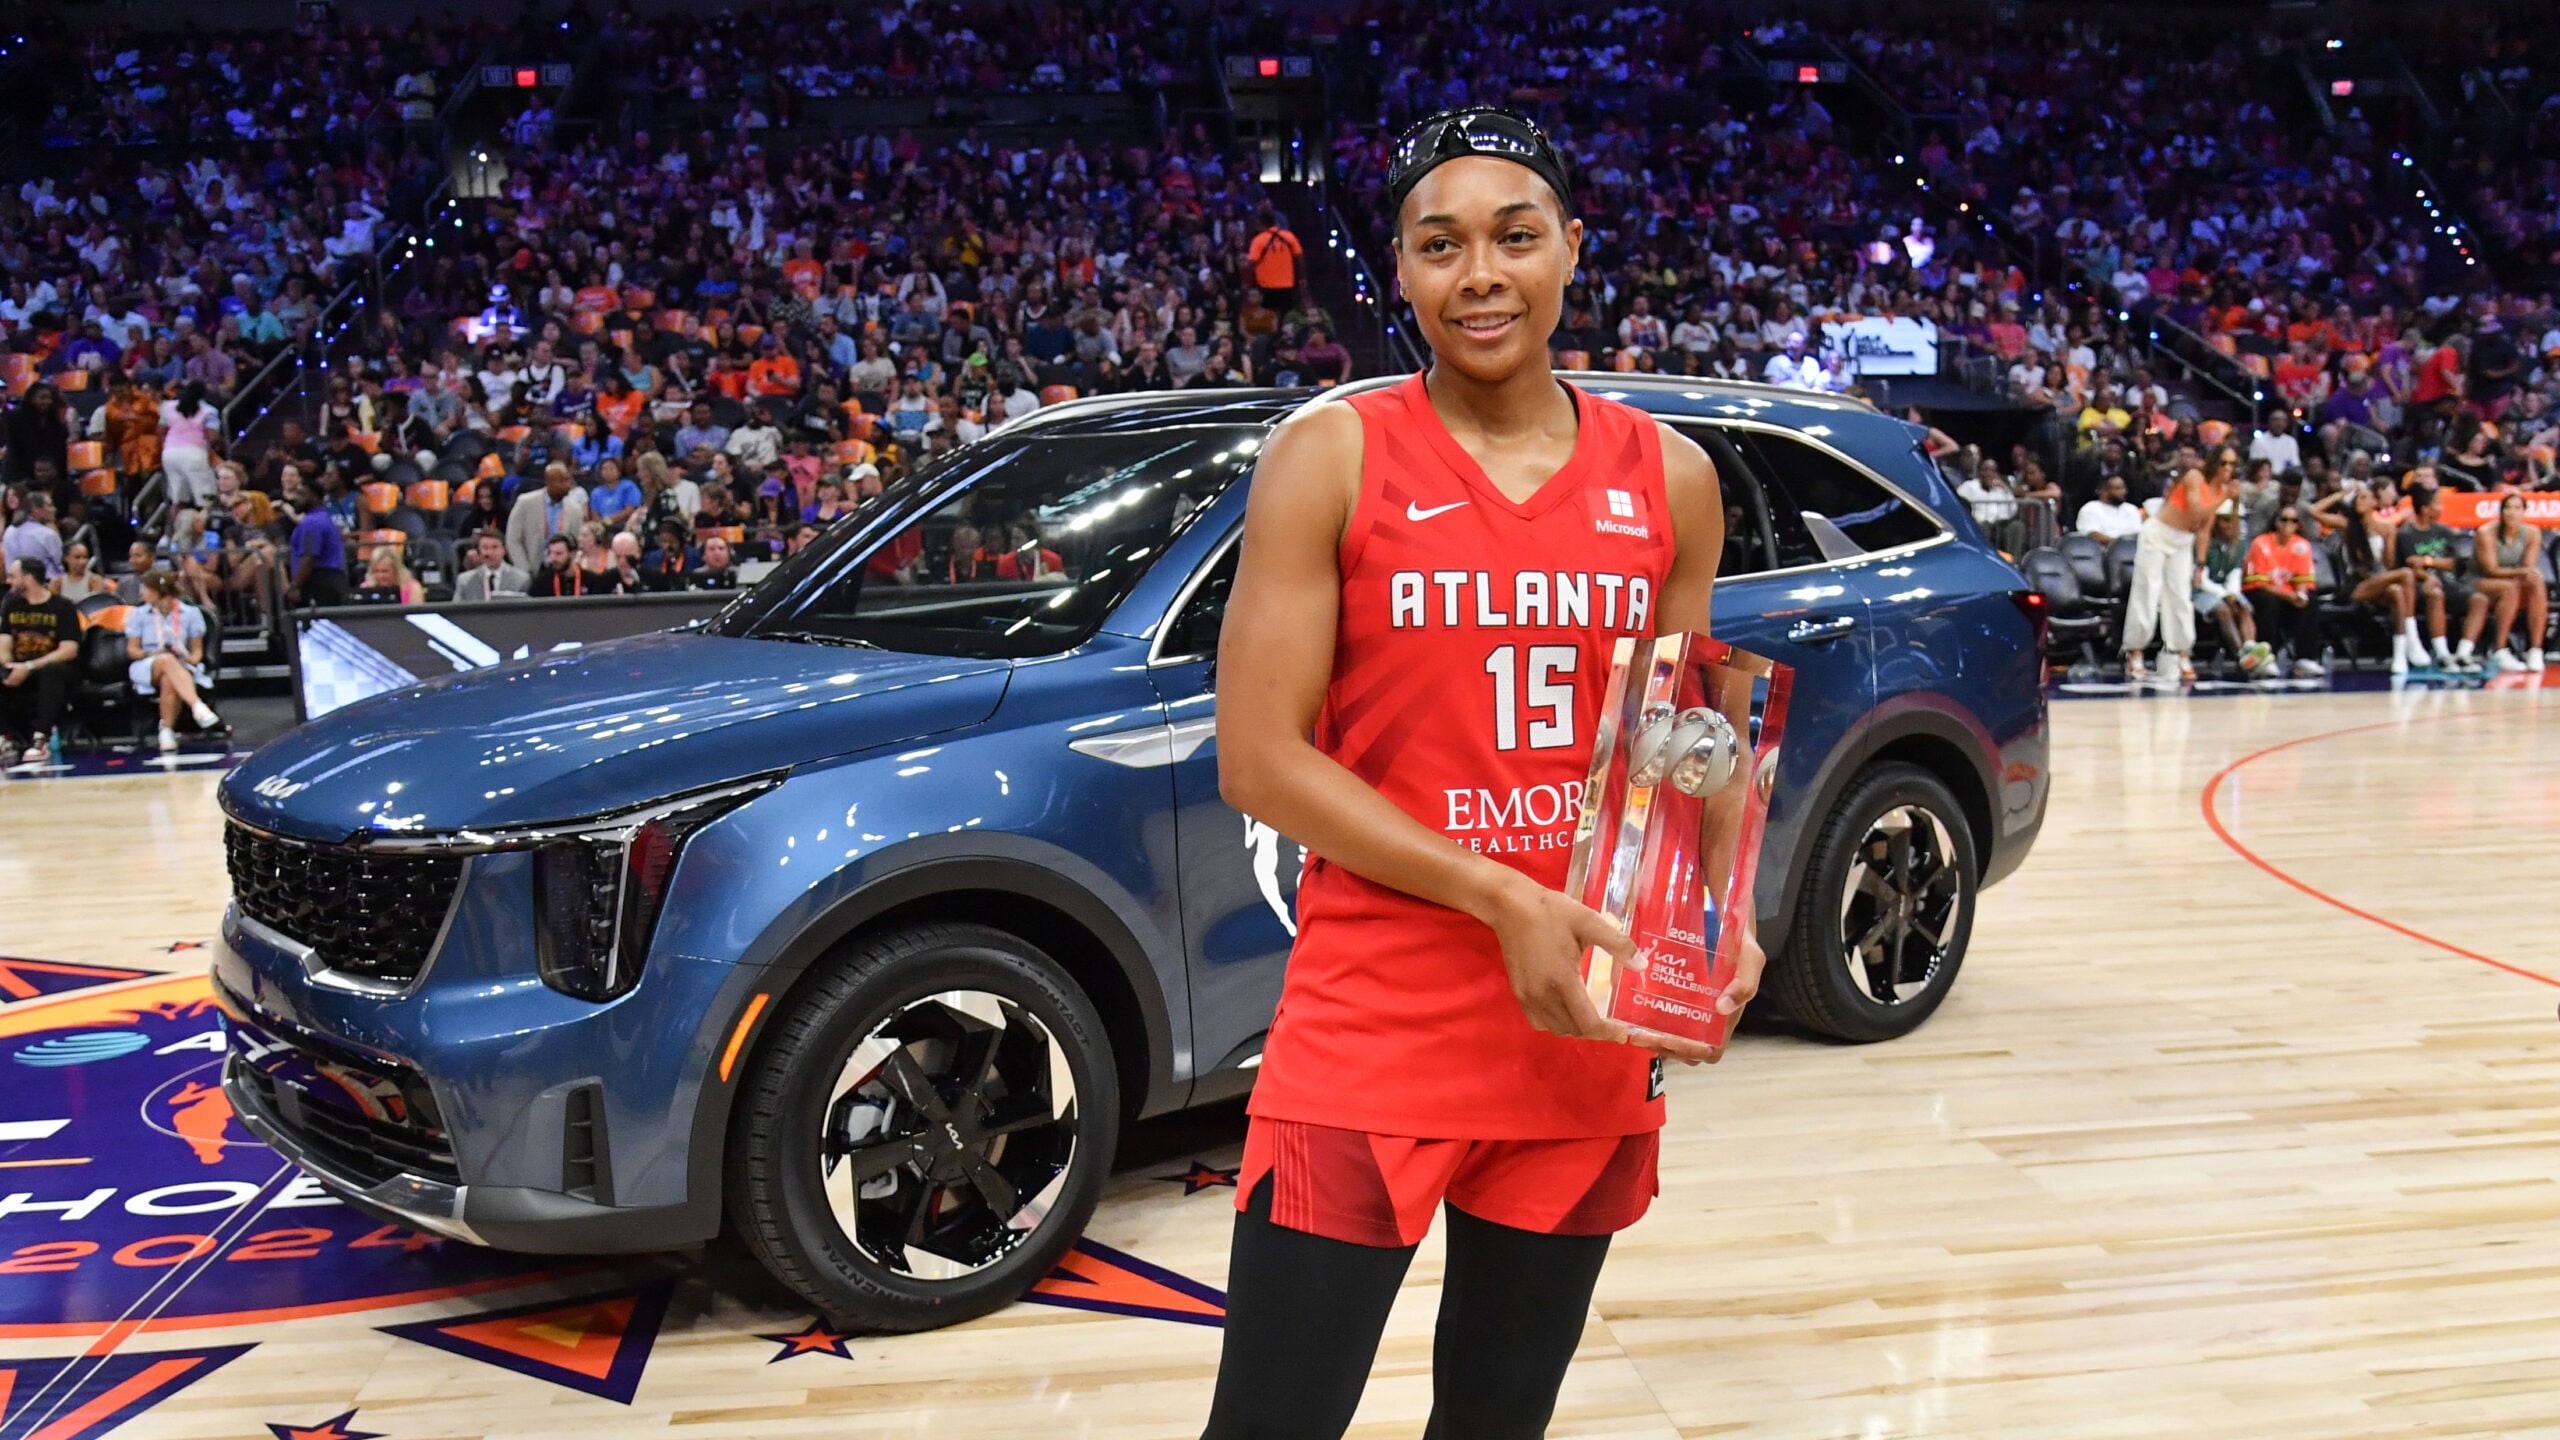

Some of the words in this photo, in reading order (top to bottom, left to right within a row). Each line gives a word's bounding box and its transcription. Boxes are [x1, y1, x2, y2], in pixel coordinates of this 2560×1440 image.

[1596, 519, 1649, 539] Microsoft
[1390, 570, 1650, 632] ATLANTA
[1485, 643, 1579, 751] 15
[1443, 780, 1588, 831] EMOR
[1453, 831, 1577, 854] EALTHC
[1667, 927, 1706, 945] 2024
[1652, 963, 1695, 981] SKILLS
[1632, 994, 1713, 1024] CHAMPION
